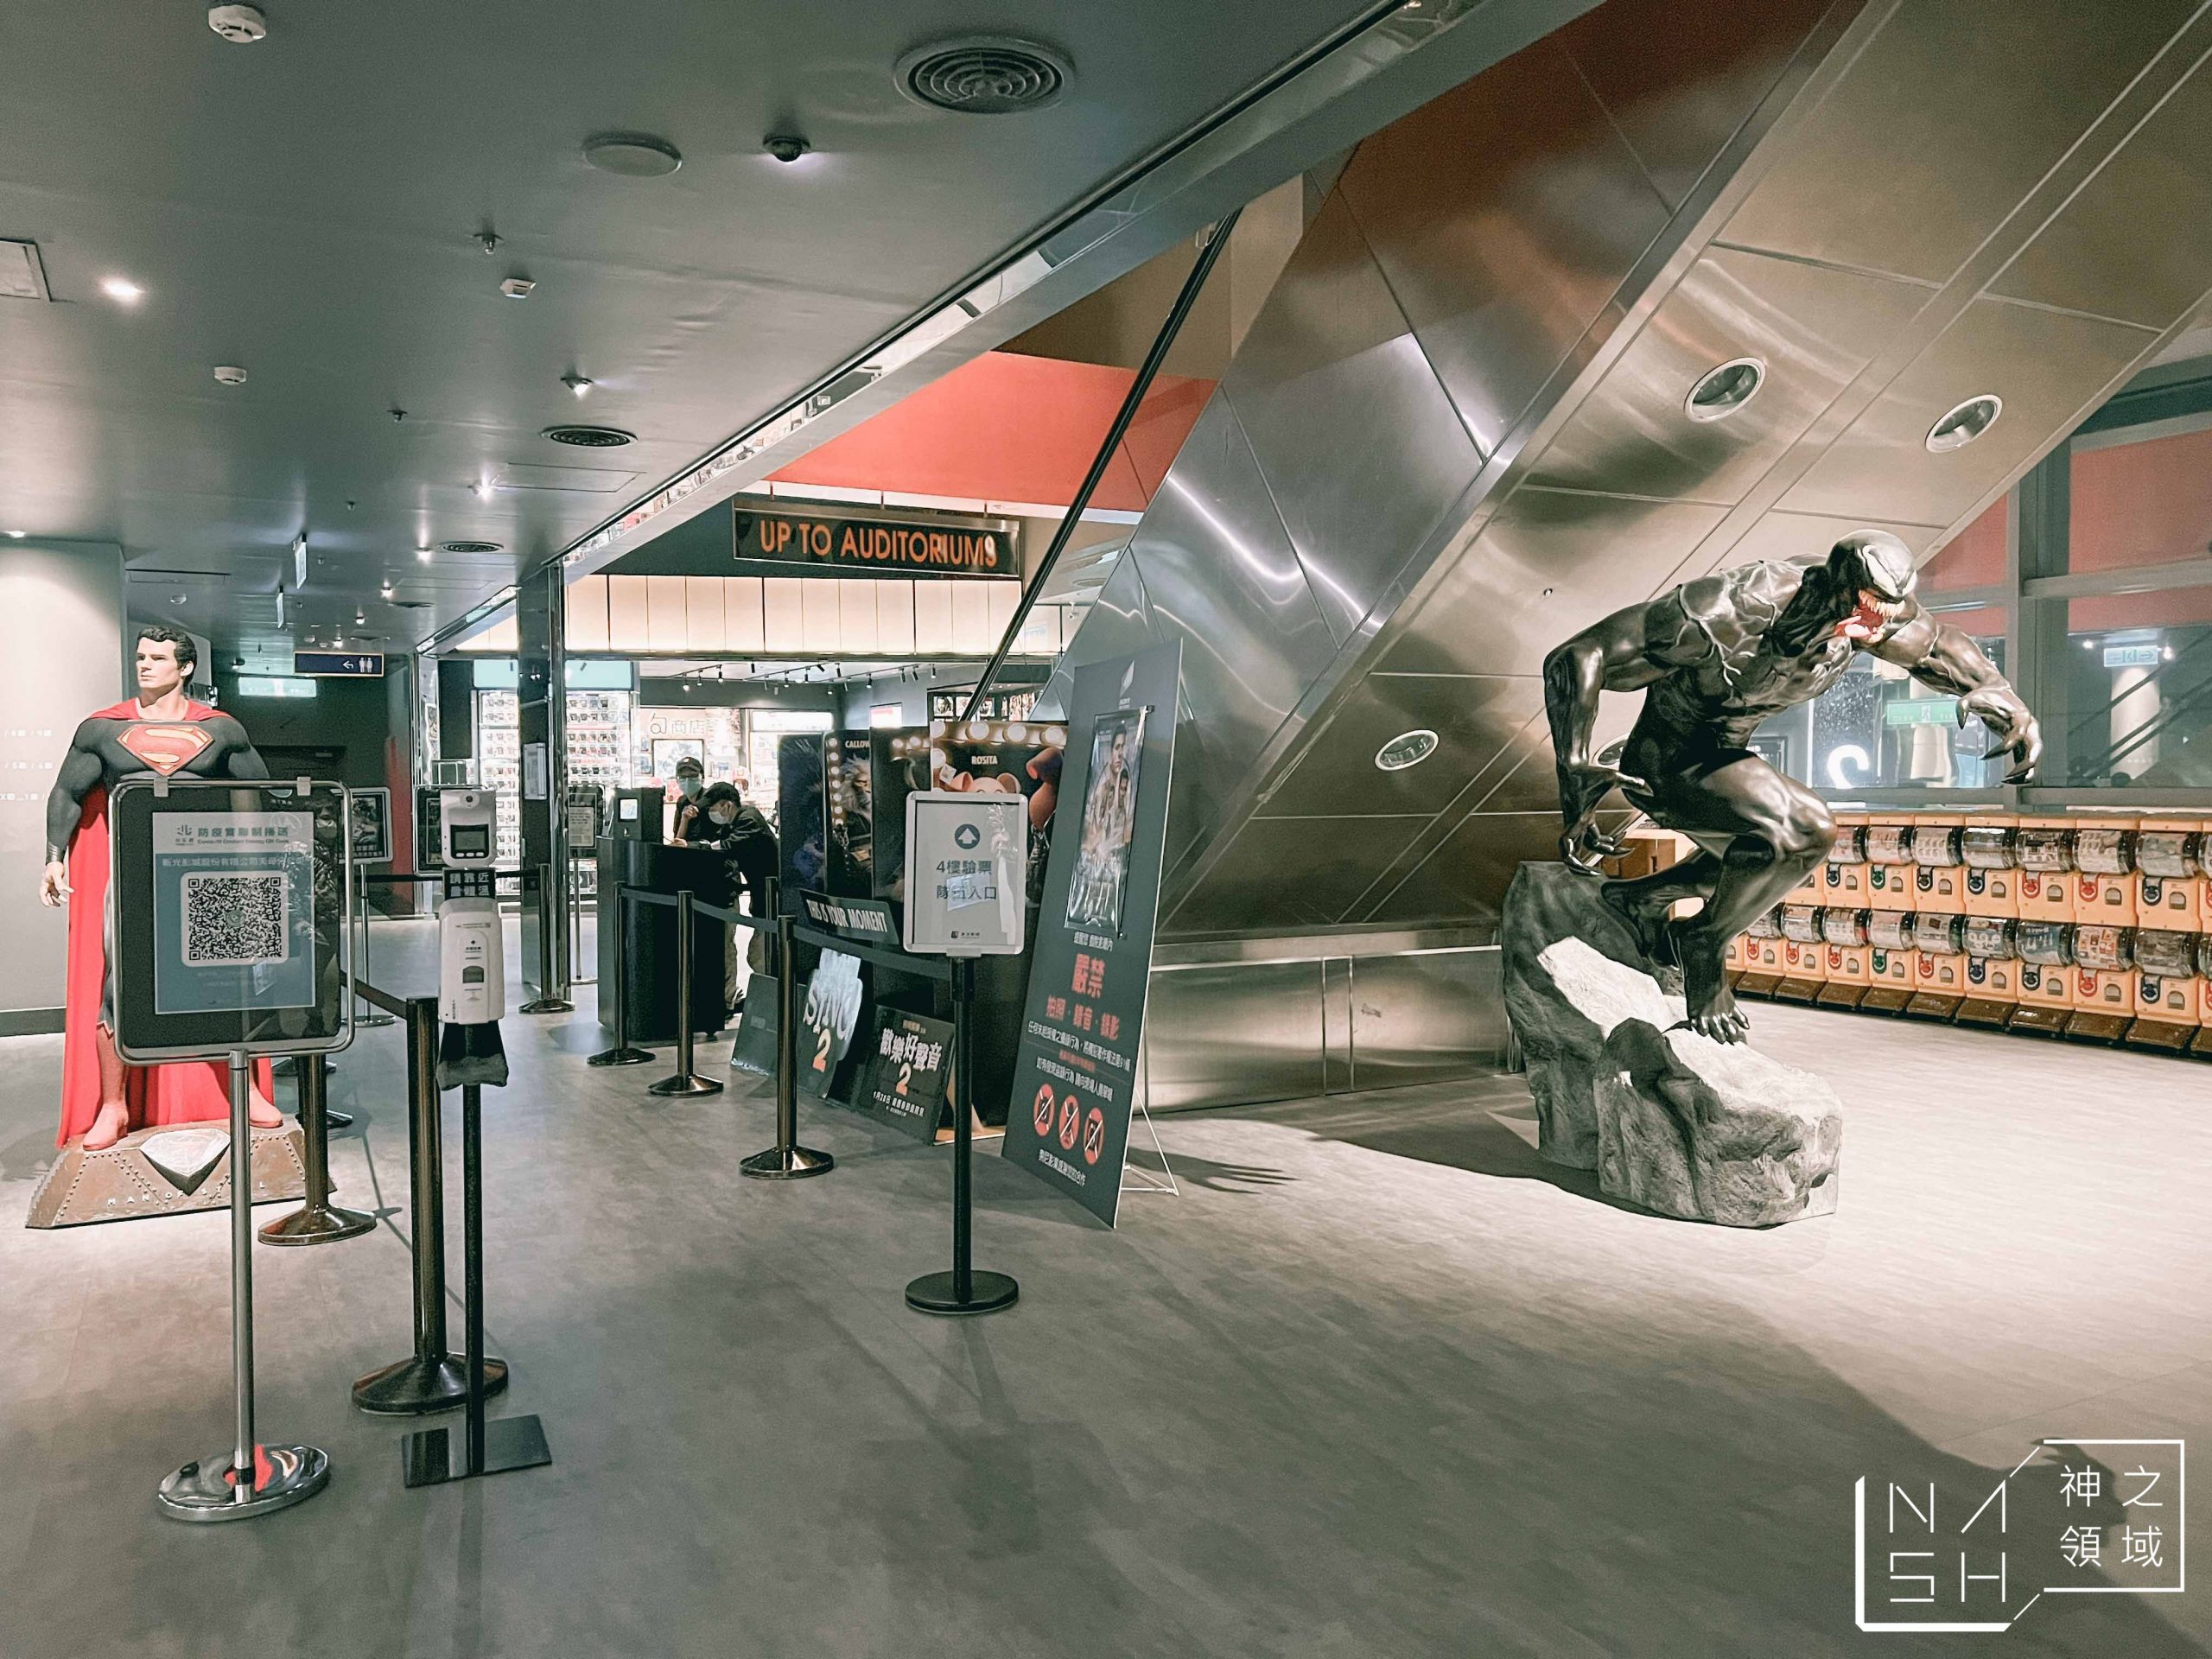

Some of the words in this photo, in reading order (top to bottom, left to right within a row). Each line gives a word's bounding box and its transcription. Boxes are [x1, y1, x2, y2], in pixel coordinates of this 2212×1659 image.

[760, 519, 790, 553] UP
[798, 523, 832, 556] TO
[840, 526, 997, 568] AUDITORIUMS
[971, 755, 998, 766] ROSITA
[936, 860, 993, 874] 4樓驗票
[825, 904, 849, 928] YOUR
[847, 908, 888, 933] MOMENT
[1071, 953, 1105, 999] 嚴禁
[811, 1028, 832, 1073] 2
[895, 1062, 912, 1096] 2
